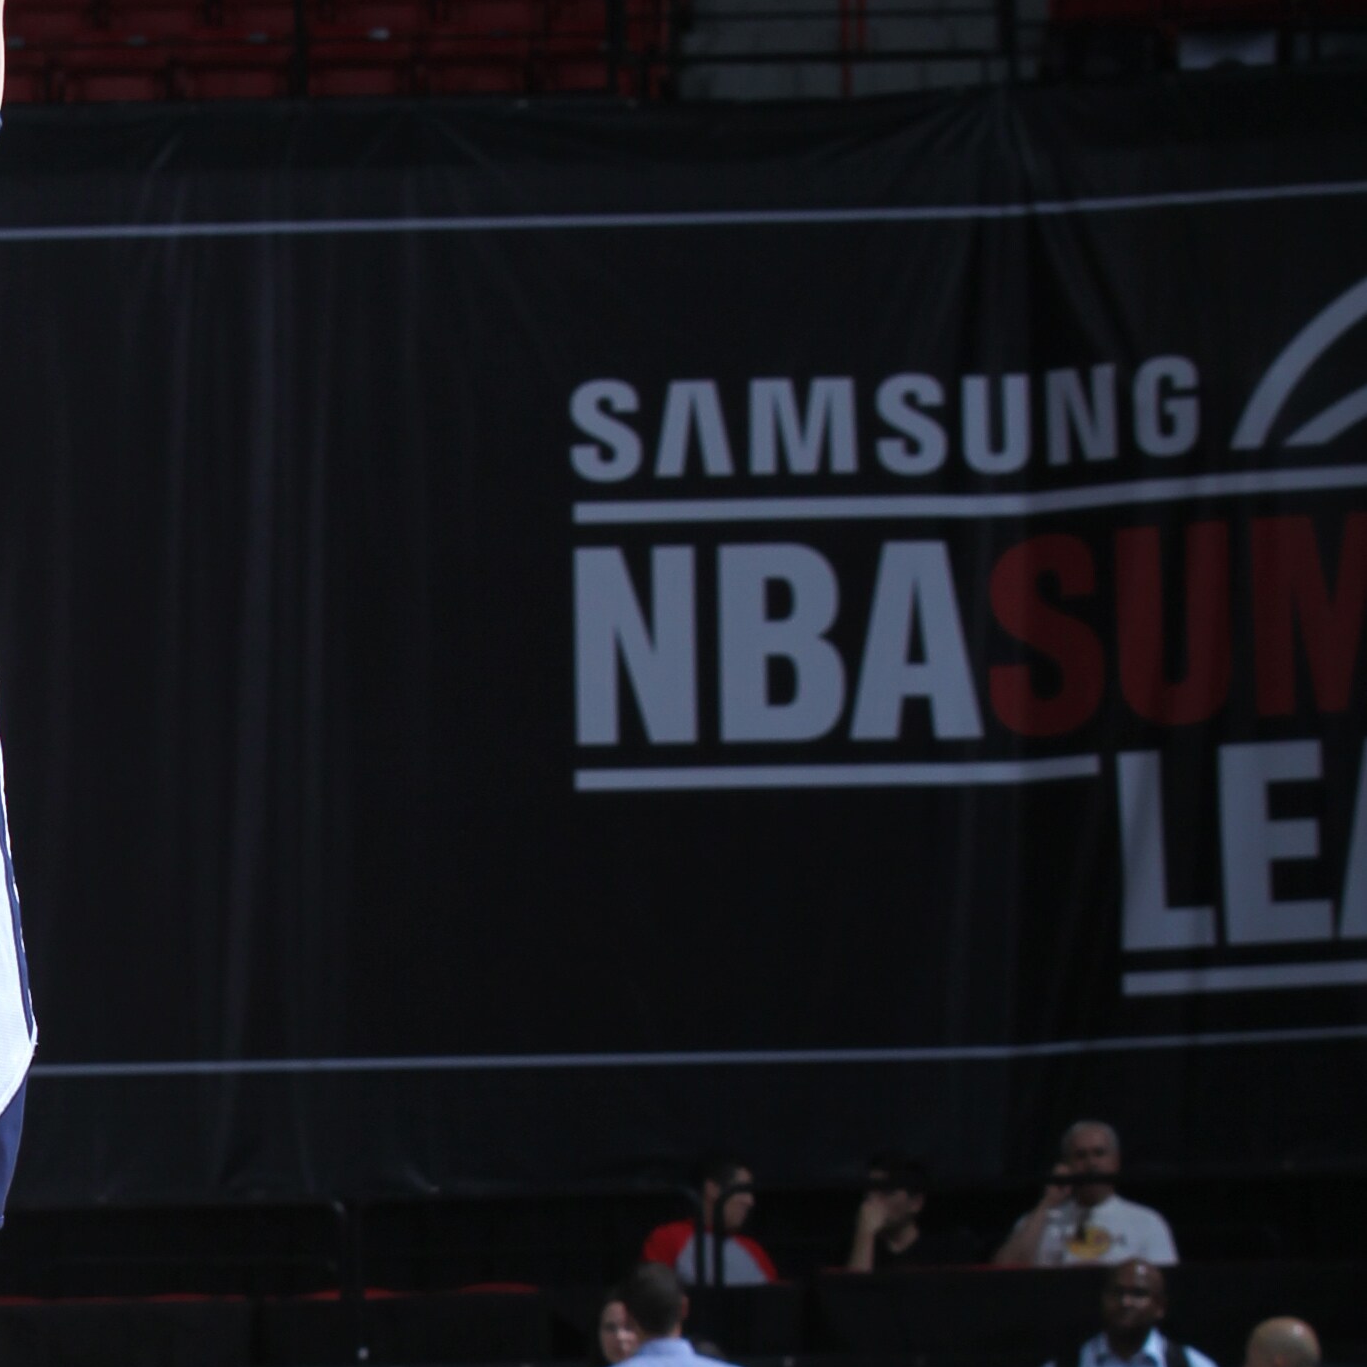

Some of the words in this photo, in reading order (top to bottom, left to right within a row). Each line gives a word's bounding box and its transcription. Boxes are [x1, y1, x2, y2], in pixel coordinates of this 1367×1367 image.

[569, 354, 1202, 483] SAMSUNG
[573, 539, 986, 746] NBA
[1116, 739, 1367, 952] LE
